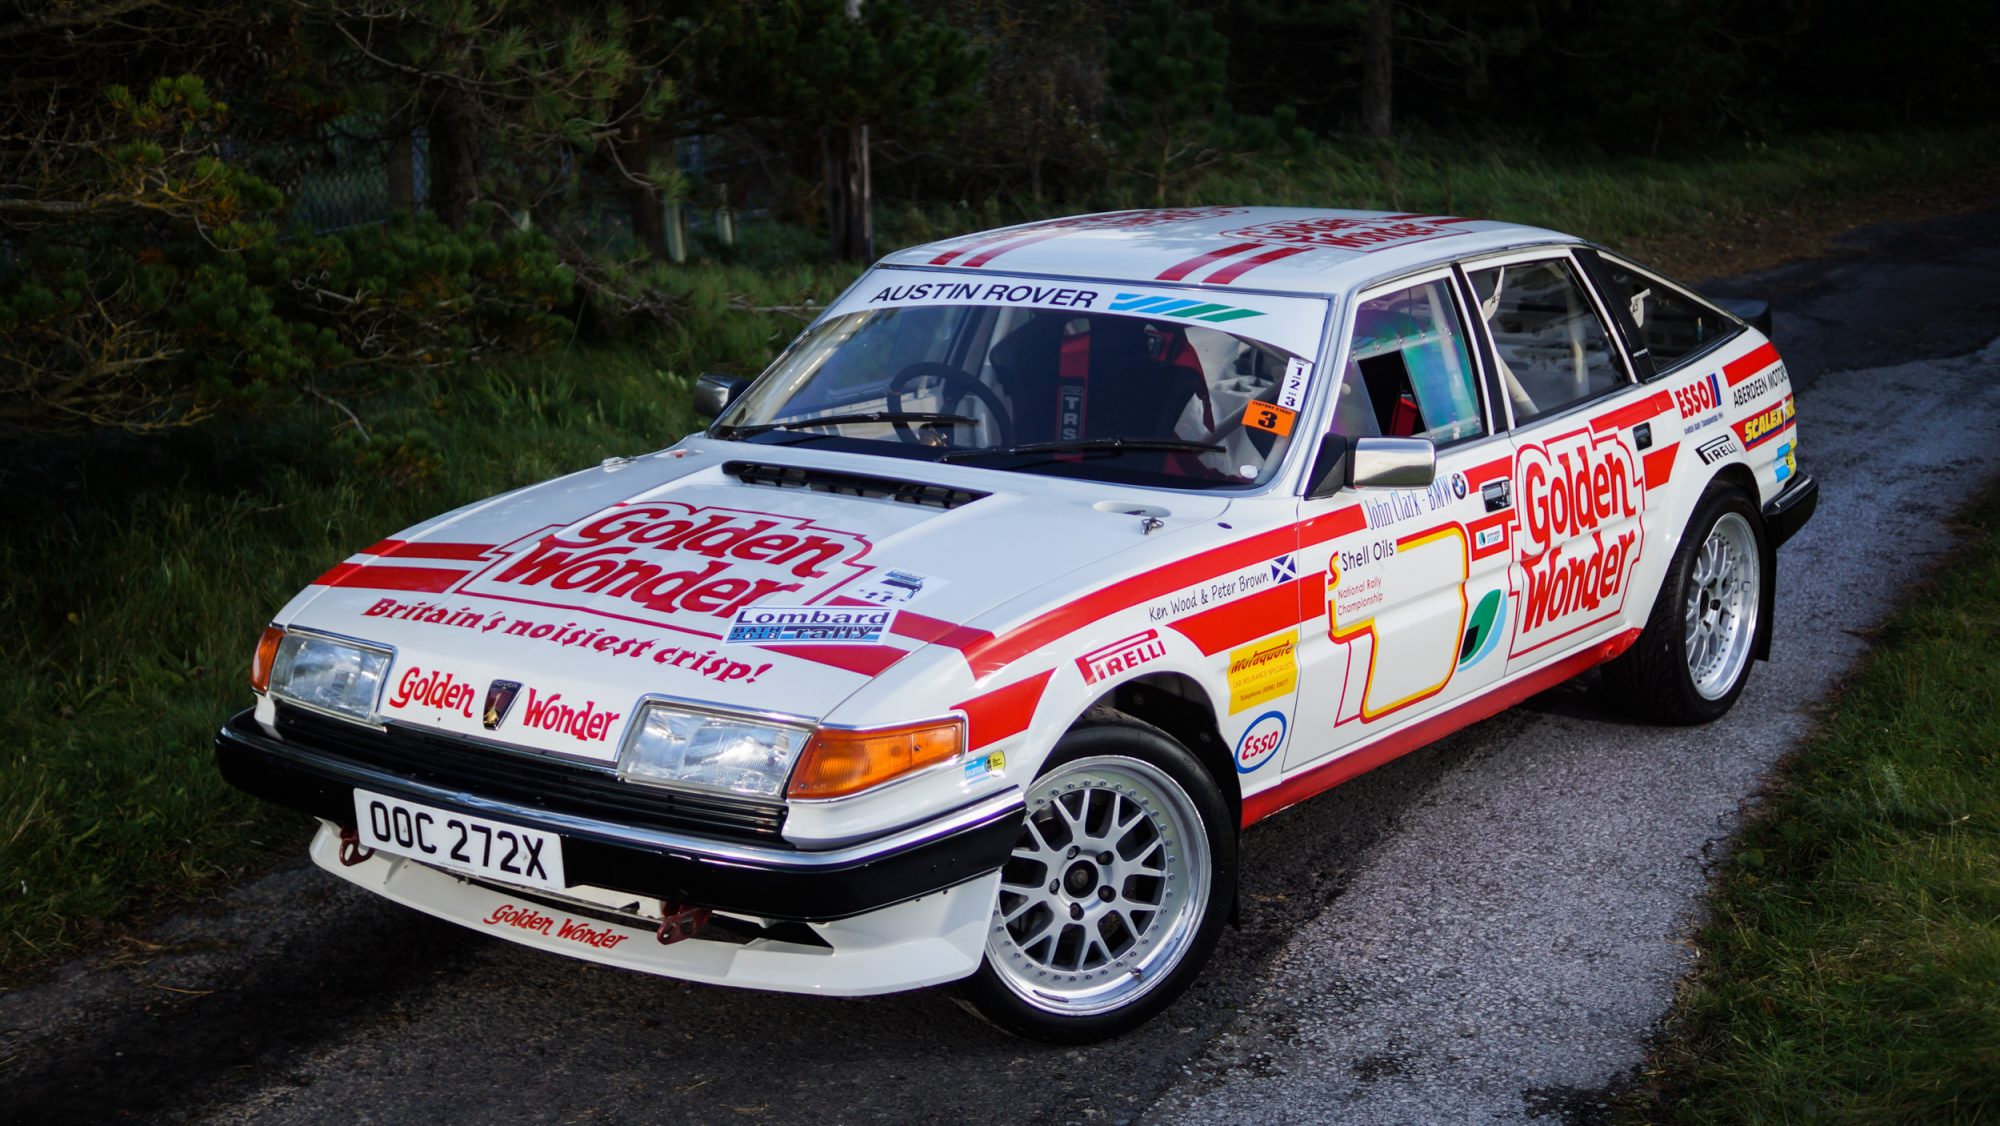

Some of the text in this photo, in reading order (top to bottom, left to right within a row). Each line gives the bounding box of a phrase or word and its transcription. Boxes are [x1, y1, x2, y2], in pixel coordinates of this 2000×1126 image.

[869, 284, 1098, 308] AUSTIN ROVER
[1289, 380, 1300, 390] 2
[1296, 367, 1303, 376] 1
[1285, 396, 1295, 406] 3
[1733, 378, 1768, 408] ABERDEEN
[1258, 411, 1278, 428] 3
[1695, 434, 1738, 465] PIRELLI
[1365, 497, 1394, 530] John
[1391, 489, 1422, 521] Clark
[1427, 475, 1452, 511] BMW
[1521, 445, 1637, 558] Golden
[553, 507, 845, 578] Golden
[1341, 539, 1394, 571] Shell Oils
[493, 537, 804, 618] Wonder
[1338, 576, 1382, 600] National Rally
[1520, 529, 1636, 634] Wonder
[1148, 572, 1269, 622] Ken Wood & Peter Brown
[1338, 591, 1383, 616] Championship
[735, 610, 890, 625] Lombard
[794, 625, 873, 640] rally
[361, 598, 773, 684] Britain's noisiest crisp!
[1074, 628, 1166, 686] PIRELLI
[389, 666, 620, 741] Golden Wonder
[370, 800, 548, 880] OOC 272X
[483, 904, 629, 950] Golden Wonder
